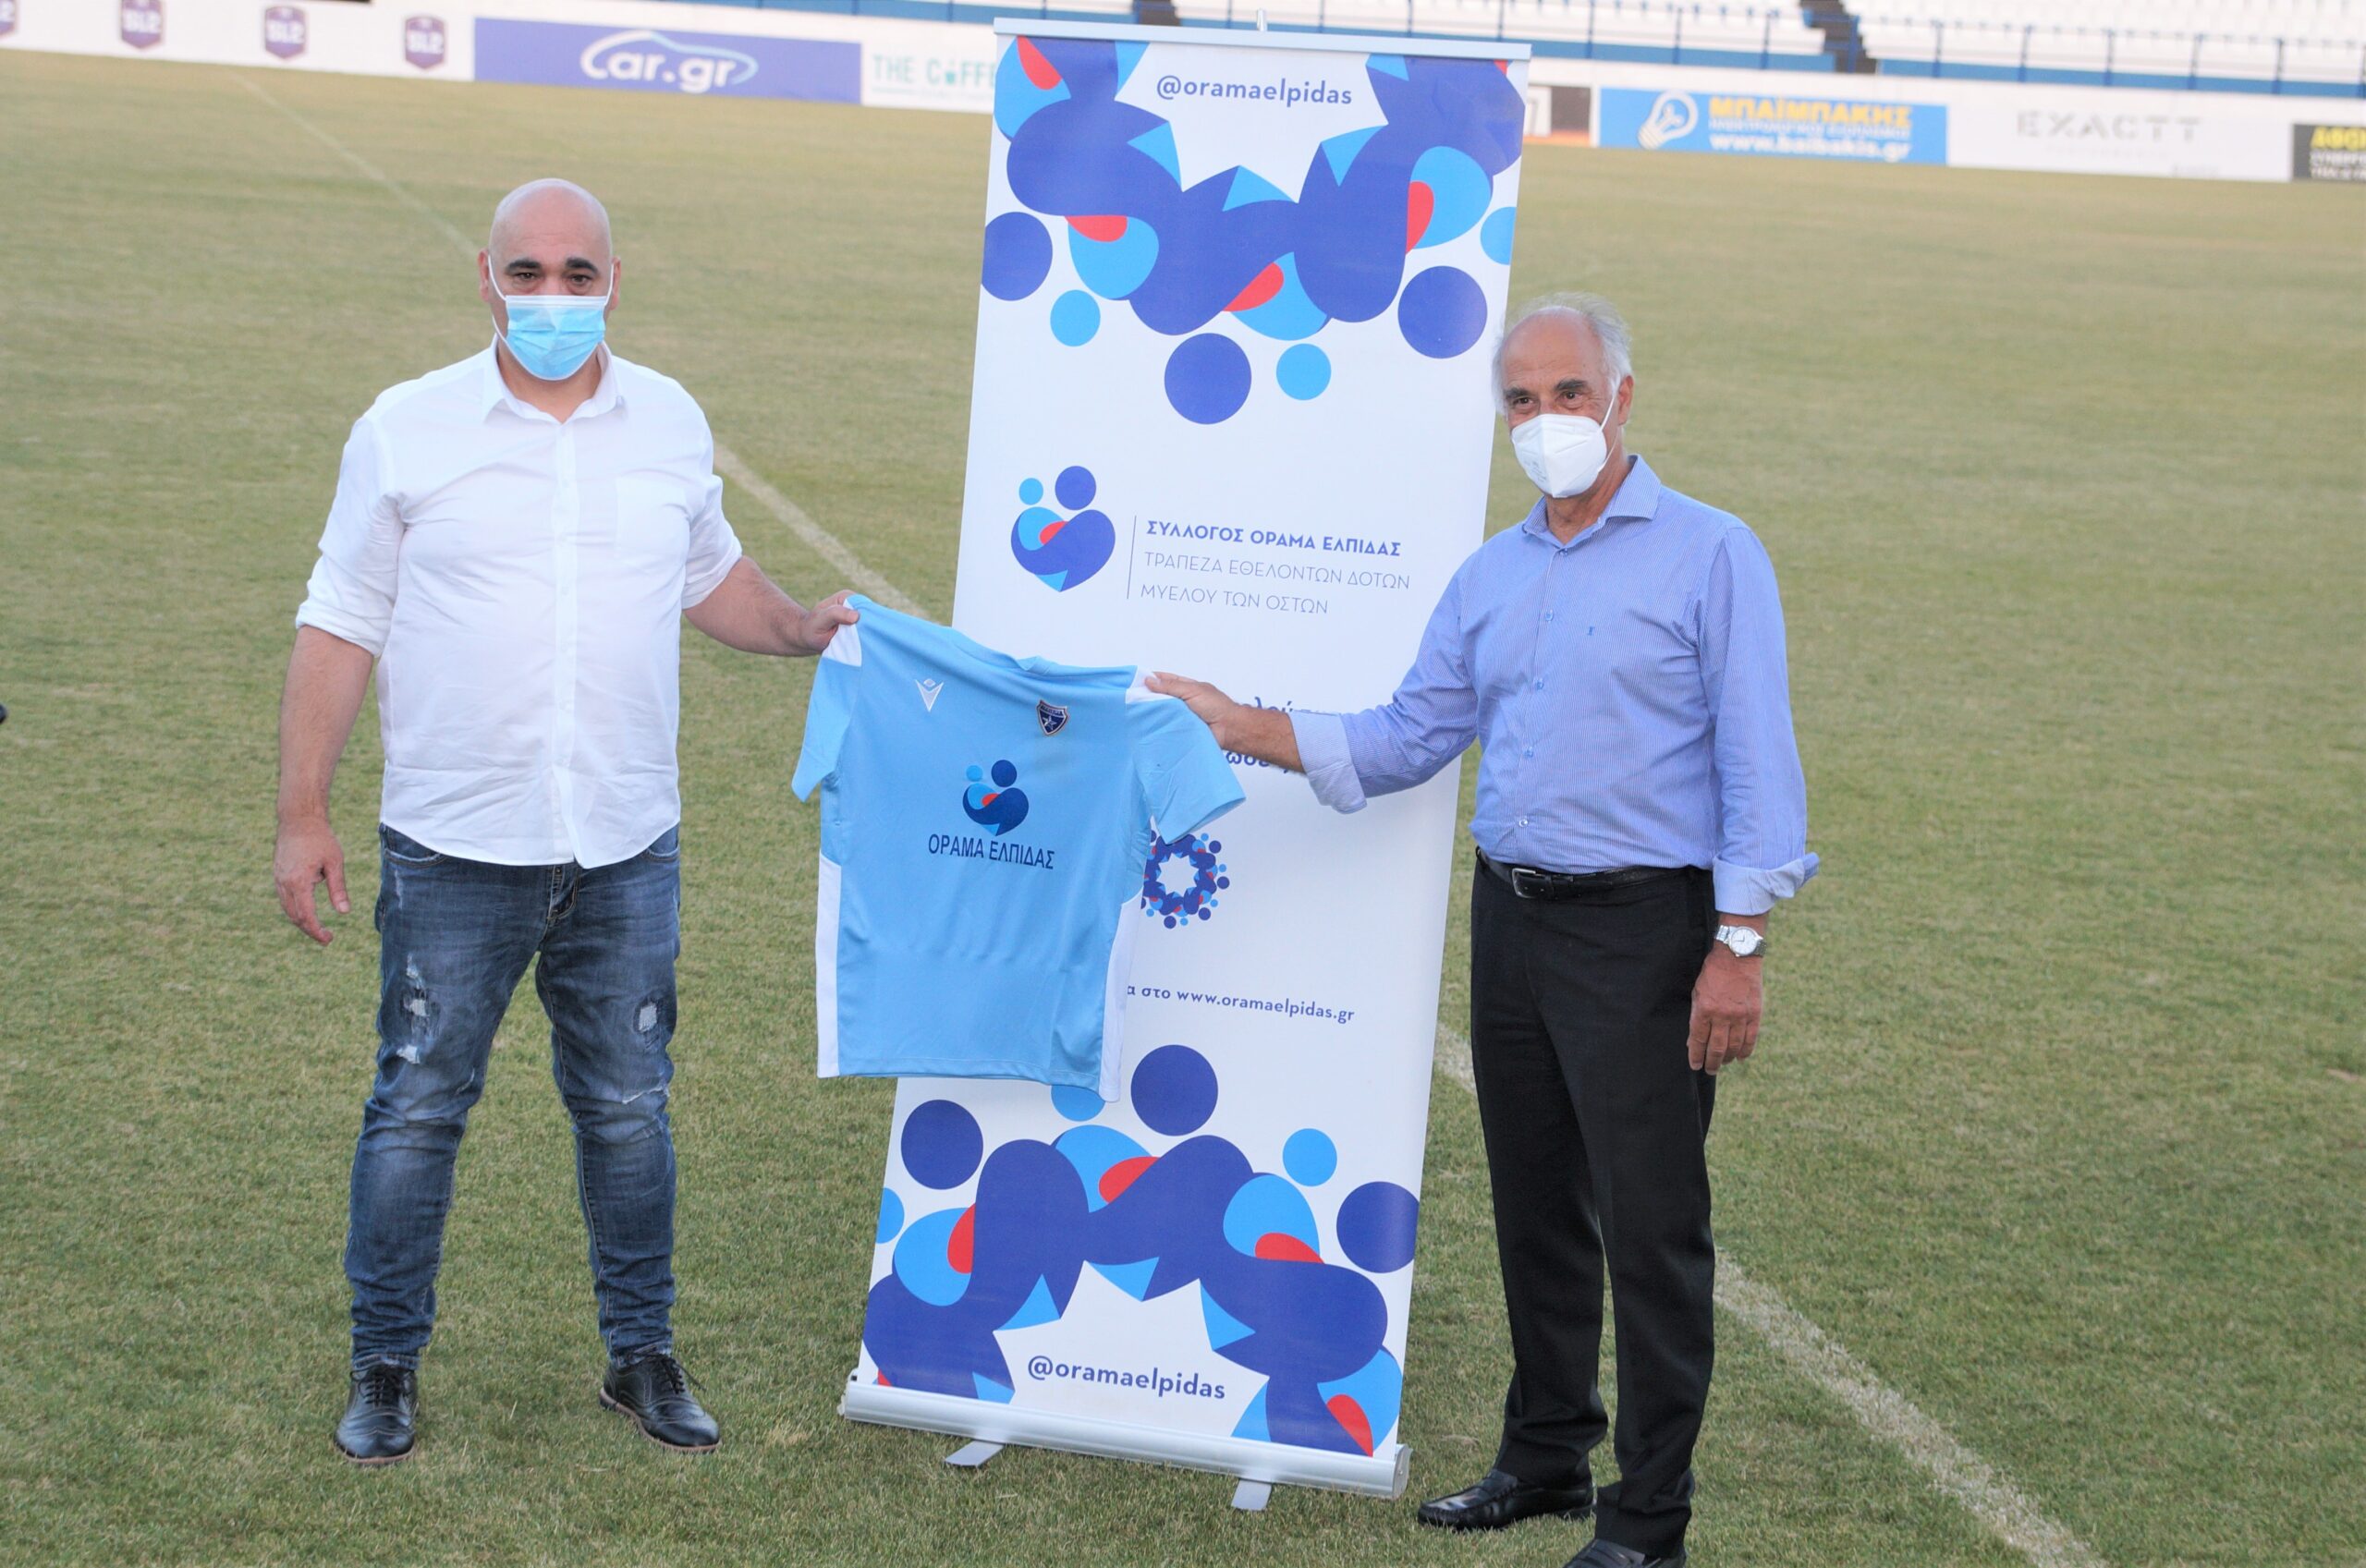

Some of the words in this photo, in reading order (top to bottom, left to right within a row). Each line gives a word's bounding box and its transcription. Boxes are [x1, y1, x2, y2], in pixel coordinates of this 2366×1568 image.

[580, 30, 737, 93] car.gr
[872, 54, 915, 84] THE
[1156, 74, 1352, 107] @oramaelpidas
[2016, 109, 2202, 142] EXACTT
[1146, 520, 1244, 542] ΣΥΛΛΟΓΟΣ
[1250, 529, 1316, 549] ΟΡΑΜΑ
[1323, 536, 1402, 556] ΕΛΠΙΔΑΣ
[1144, 552, 1223, 574] ΤΡΑΠΕΖΑ
[1229, 559, 1342, 584] ΕΘΕΛΟΝΤΩΝ
[1348, 570, 1410, 590] ΔΟΤΩΝ
[1140, 584, 1217, 604] ΜΥΕΛΟΥ
[1223, 590, 1260, 608] ΤΩΝ
[1266, 595, 1328, 614] ΟΣΤΩΝ
[928, 833, 984, 858] ΟΡΑΜΑ
[989, 840, 1055, 869] ΕΛΠΙΔΑΣ
[1141, 986, 1171, 999] στο
[1177, 990, 1356, 1024] www.oramaelpidas.gr
[1028, 1355, 1226, 1399] @oramaelpidas
